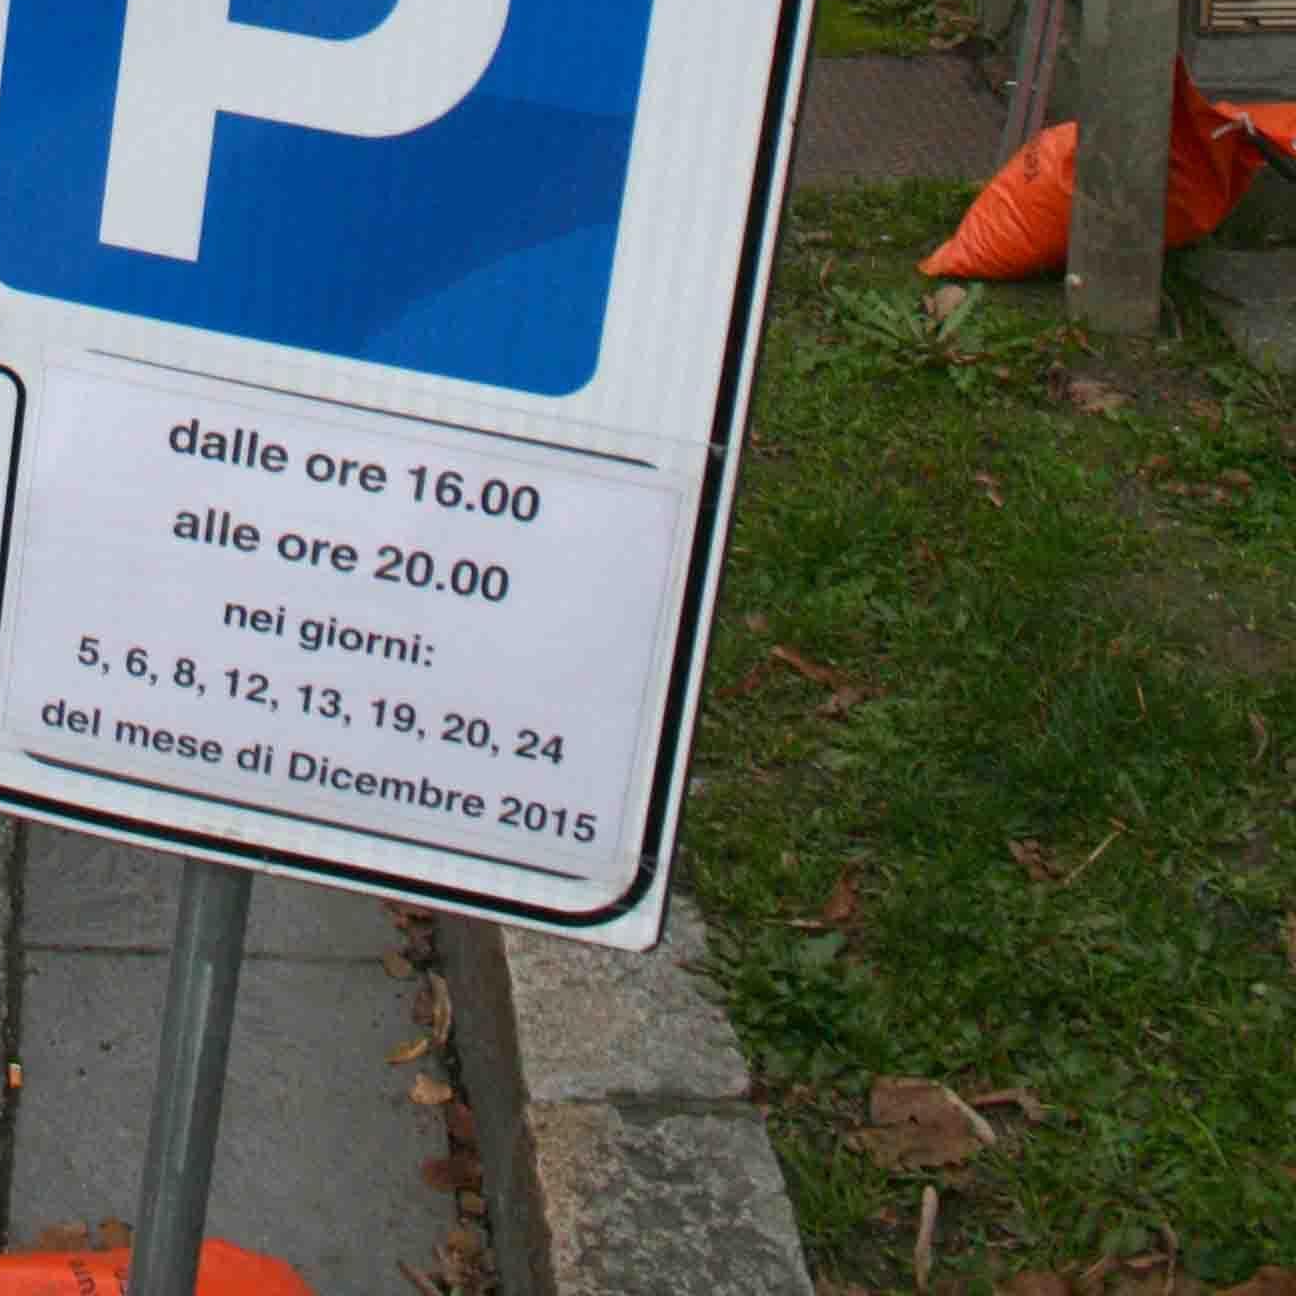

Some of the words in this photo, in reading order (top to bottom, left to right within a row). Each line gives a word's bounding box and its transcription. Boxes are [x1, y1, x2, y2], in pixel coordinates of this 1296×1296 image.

[169, 418, 289, 473] dalle
[305, 451, 387, 494] ore
[408, 464, 541, 523] 16.00
[173, 507, 261, 552] alle
[277, 530, 359, 573] ore
[374, 544, 511, 603] 20.00
[223, 601, 285, 637] nei
[299, 614, 435, 667] giorni:
[77, 636, 110, 673] 5,
[125, 647, 158, 684] 6,
[173, 657, 207, 696] 8,
[223, 668, 280, 711] 12,
[297, 683, 352, 726] 13,
[370, 698, 426, 740] 19,
[442, 713, 499, 755] 20,
[514, 728, 565, 766] 24
[41, 699, 101, 738] del
[114, 716, 224, 764] mese
[237, 742, 274, 777] di
[288, 750, 487, 820] Dicembre
[498, 795, 598, 845] 2015
